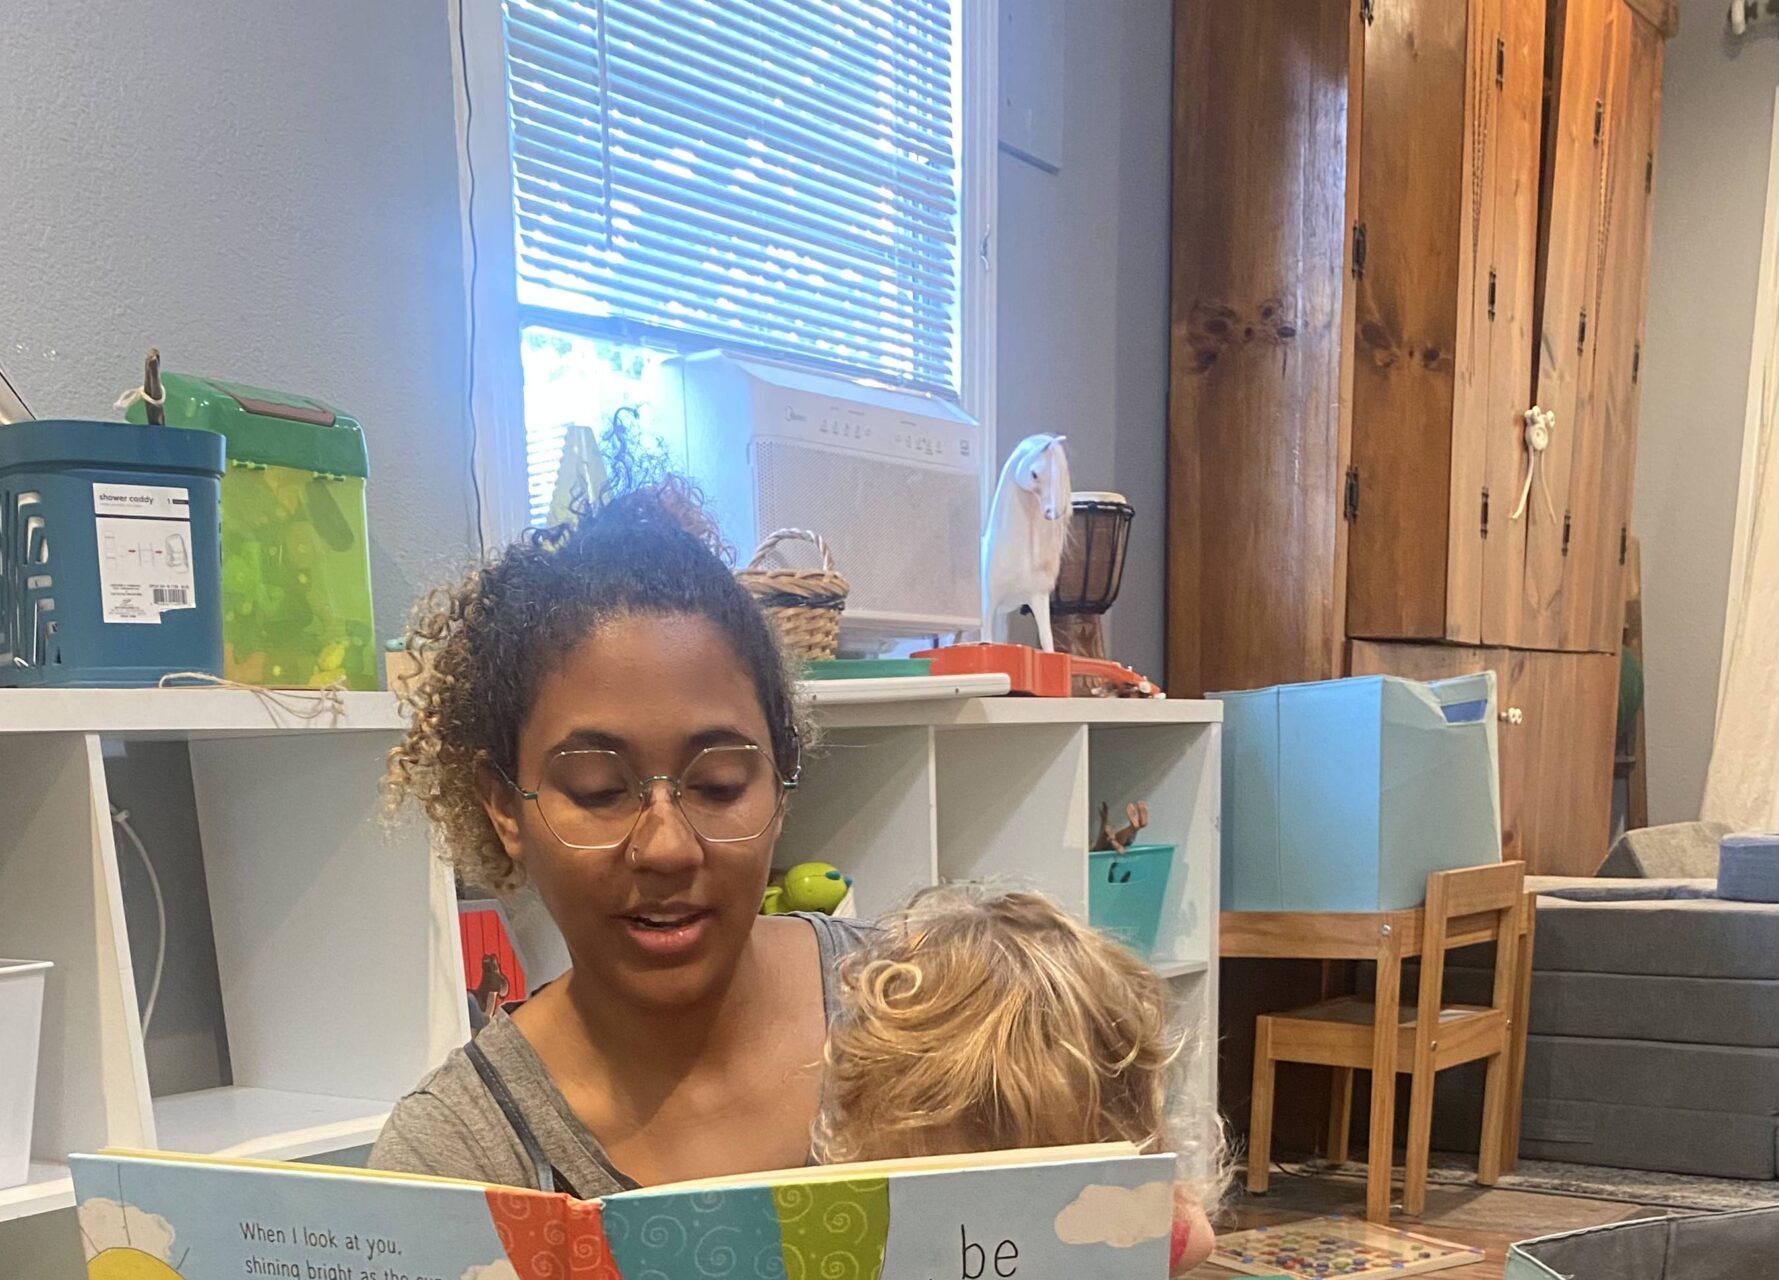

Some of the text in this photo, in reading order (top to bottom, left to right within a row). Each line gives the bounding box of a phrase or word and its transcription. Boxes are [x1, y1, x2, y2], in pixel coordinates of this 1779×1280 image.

[99, 493, 154, 504] shower caddy
[240, 1222, 285, 1244] When
[292, 1227, 297, 1245] I
[304, 1227, 338, 1249] look
[345, 1234, 360, 1251] at
[960, 1224, 1018, 1280] be
